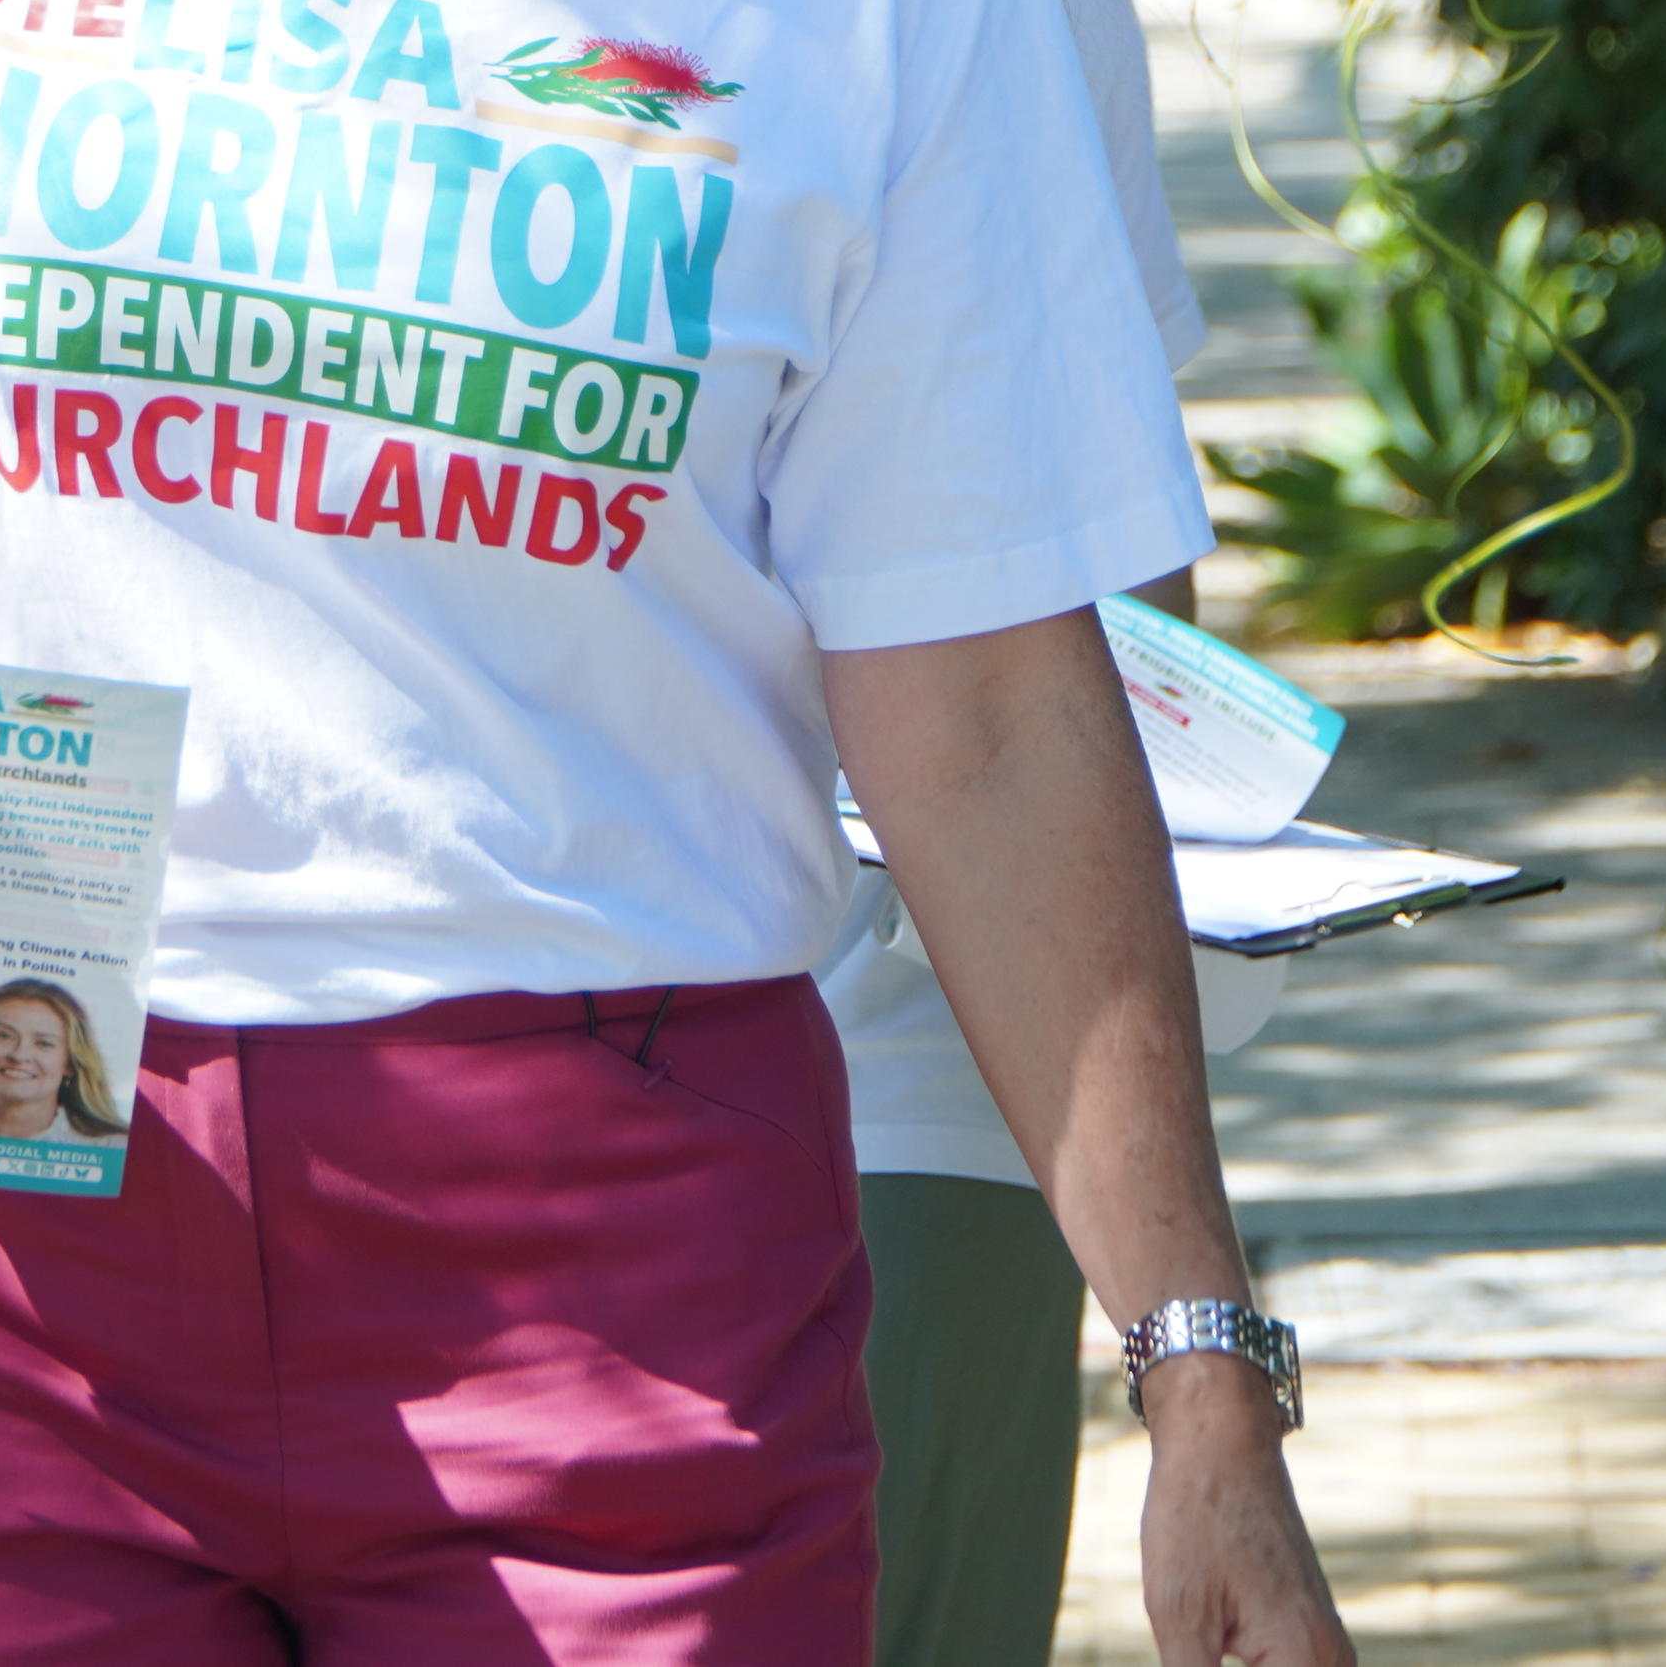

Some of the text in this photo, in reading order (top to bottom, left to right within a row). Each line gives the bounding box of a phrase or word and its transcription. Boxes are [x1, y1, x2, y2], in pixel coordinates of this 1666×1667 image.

[496, 347, 685, 466] FOR
[62, 797, 154, 822] Independent
[9, 810, 65, 827] because
[95, 823, 127, 835] time
[131, 826, 151, 839] for
[15, 827, 44, 841] first
[48, 835, 75, 846] and
[79, 838, 106, 850] acts
[110, 843, 142, 855] with
[12, 880, 49, 894] these
[53, 885, 77, 901] key
[21, 869, 75, 885] political
[79, 878, 115, 893] party
[2, 955, 17, 968] in
[21, 958, 77, 977] Politics
[19, 940, 77, 960] Climate
[80, 950, 130, 967] Action
[47, 1149, 104, 1165] MEDIA:
